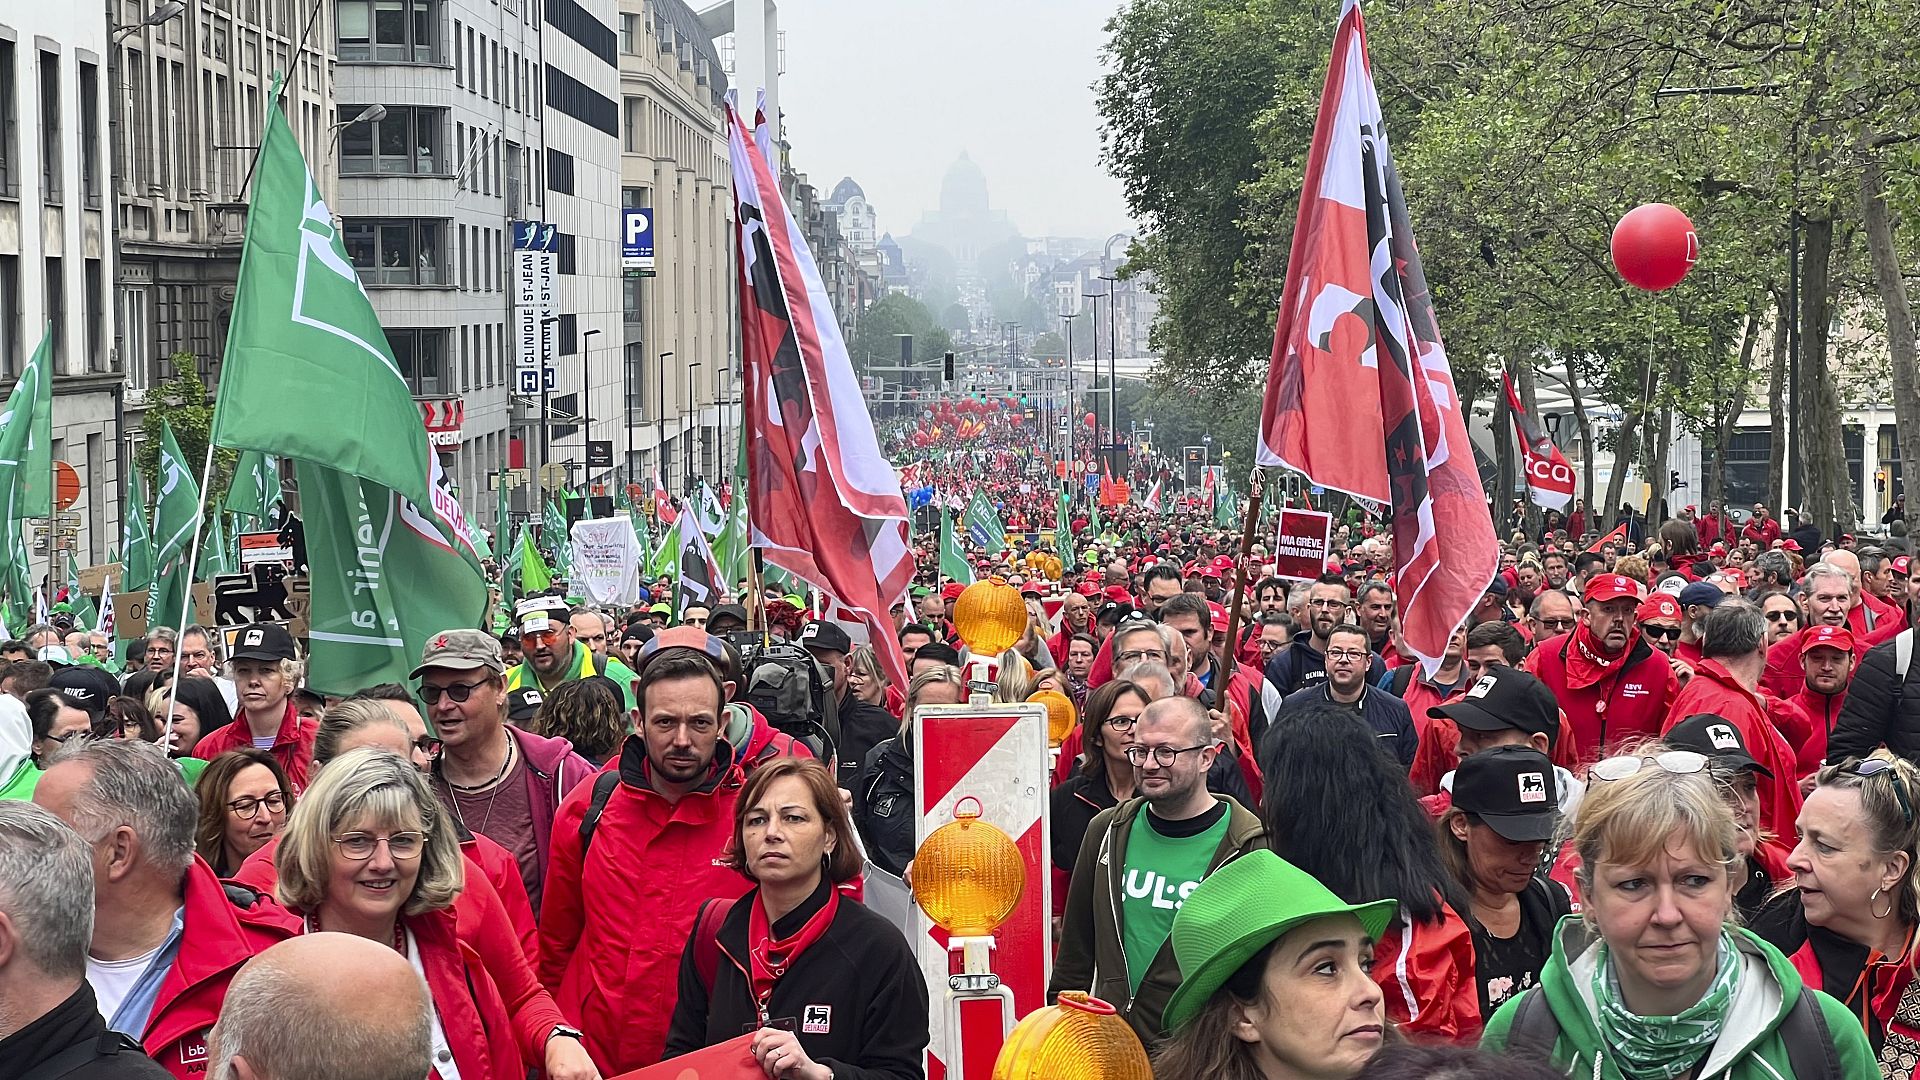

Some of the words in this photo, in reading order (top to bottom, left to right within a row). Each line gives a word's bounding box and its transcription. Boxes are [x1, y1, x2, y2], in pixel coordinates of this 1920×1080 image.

[626, 213, 648, 245] P
[522, 254, 534, 302] ST-JEAN
[541, 256, 550, 301] ST-JAN
[523, 308, 535, 364] CLINIQUE
[542, 309, 551, 365] KLINIK
[1280, 545, 1300, 557] MON
[1300, 547, 1324, 560] DROIT
[1281, 534, 1295, 546] MA
[63, 687, 87, 698] NIKE
[188, 1044, 208, 1057] bb
